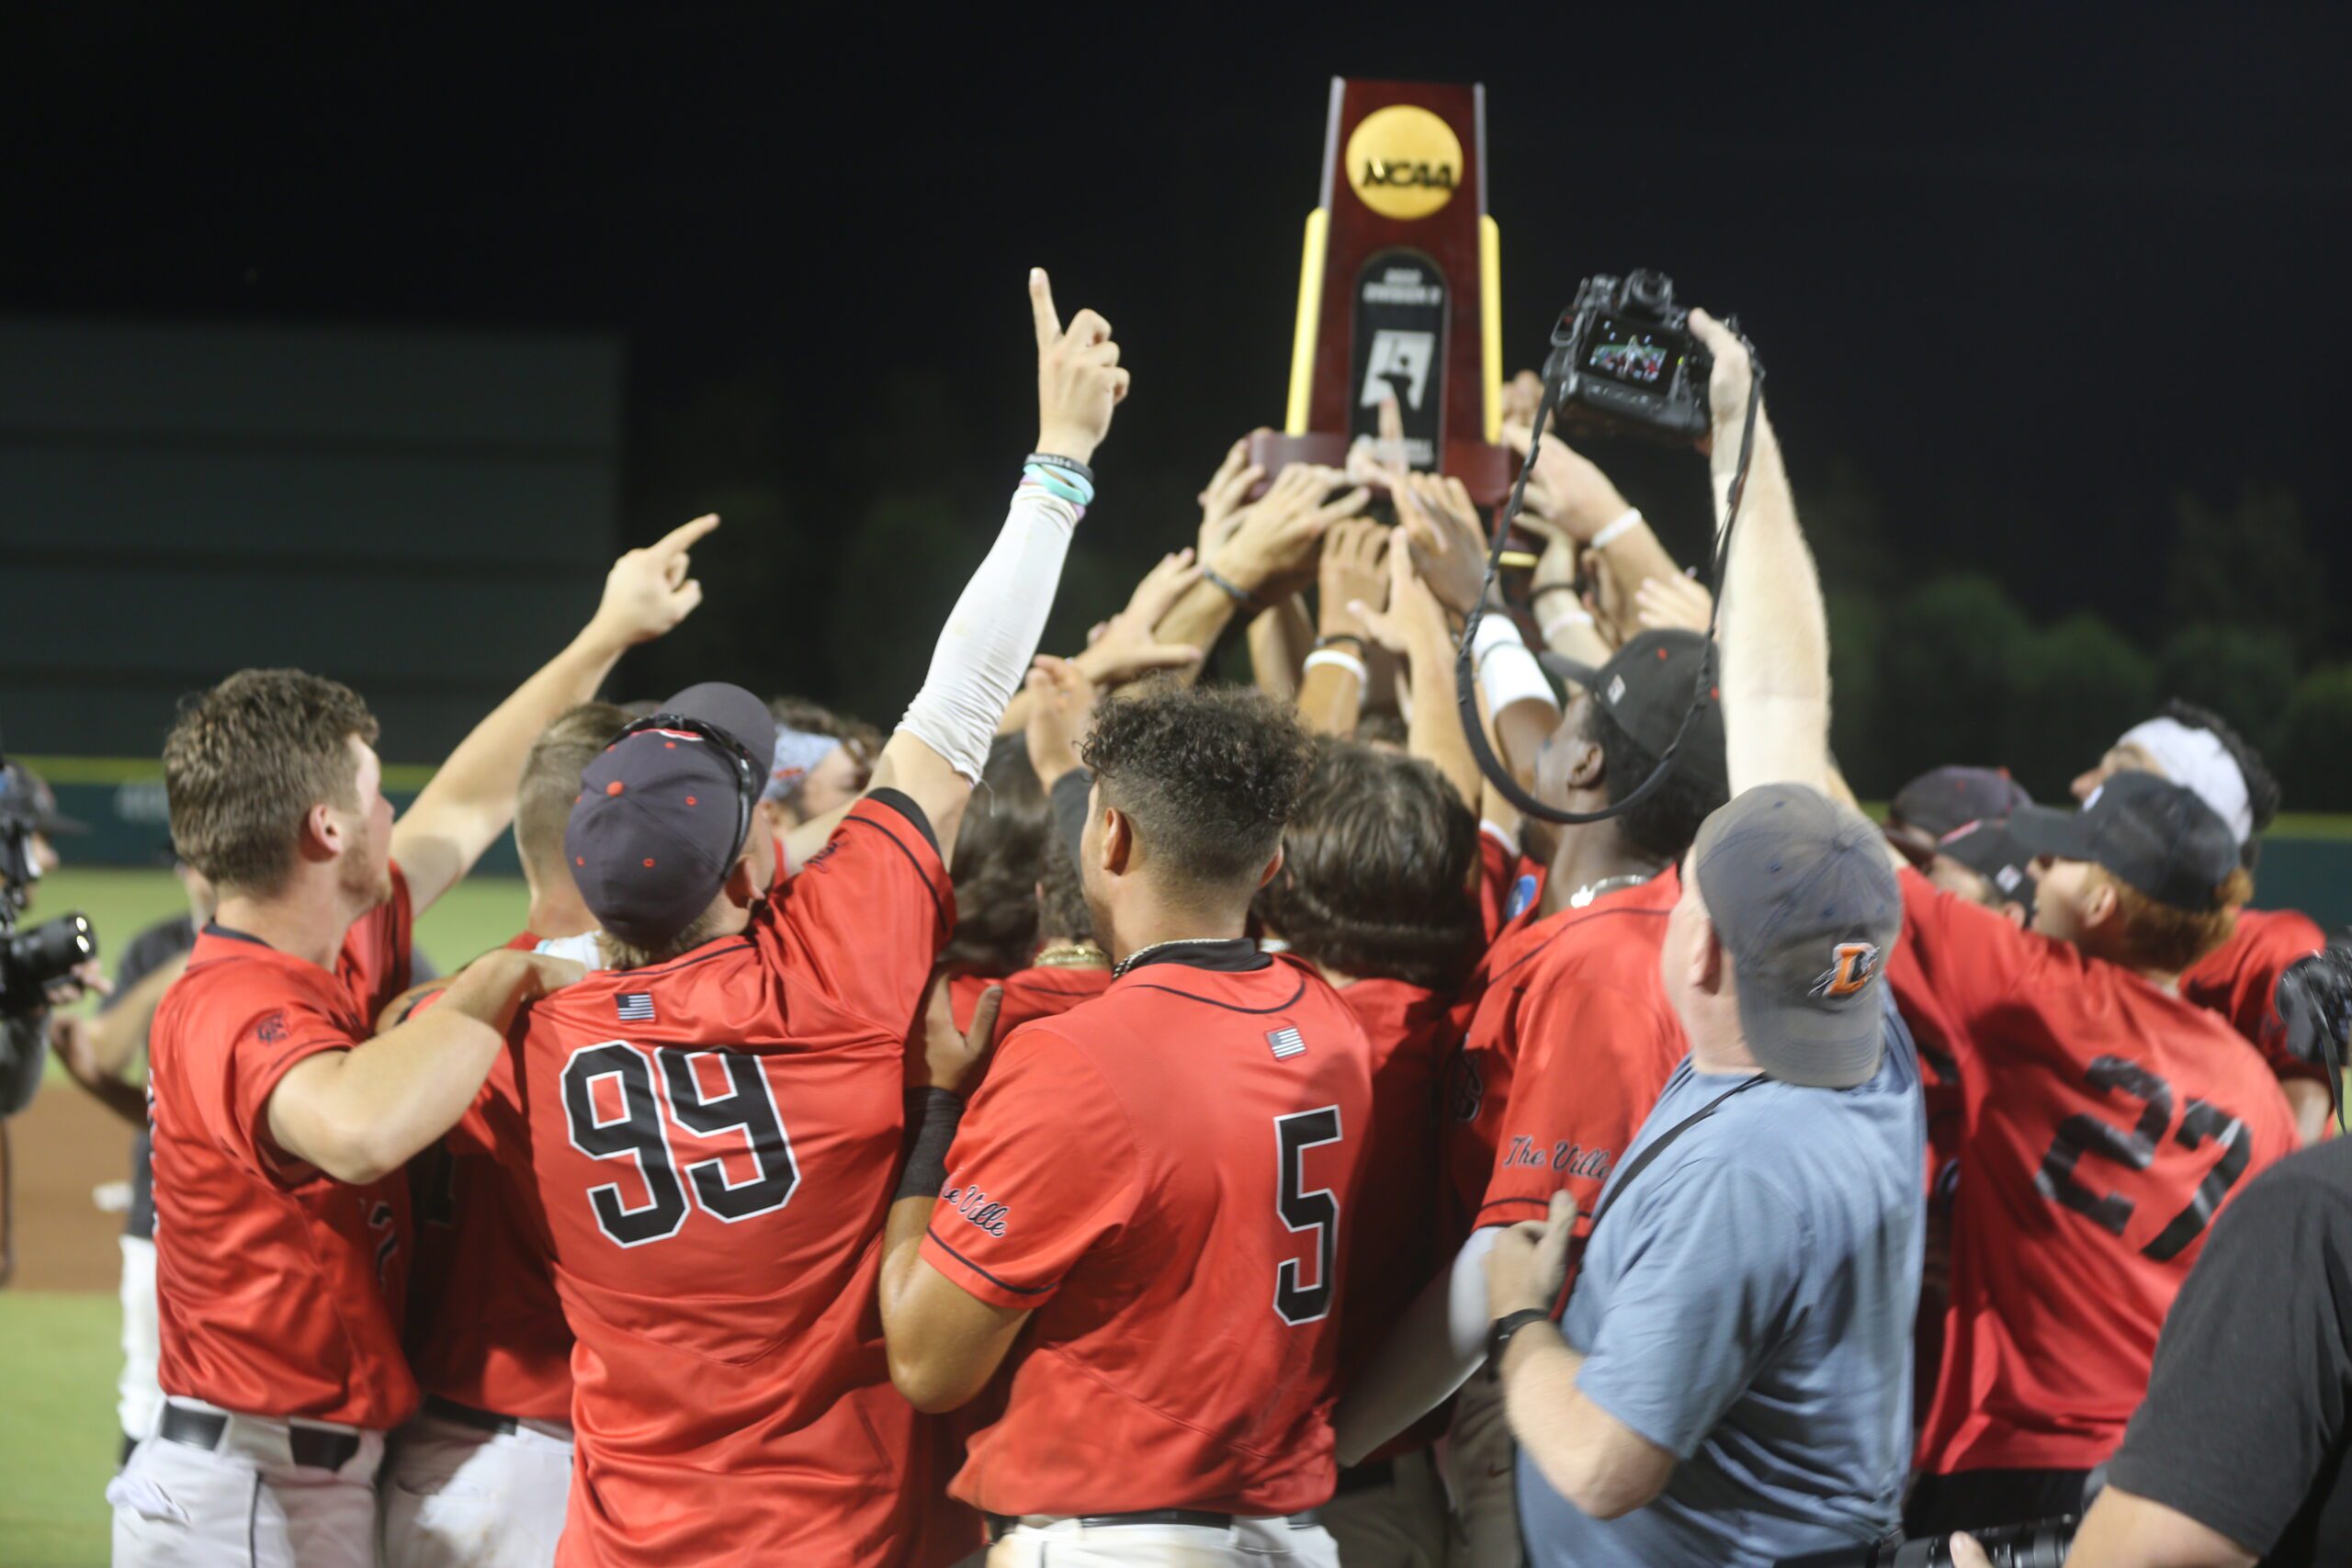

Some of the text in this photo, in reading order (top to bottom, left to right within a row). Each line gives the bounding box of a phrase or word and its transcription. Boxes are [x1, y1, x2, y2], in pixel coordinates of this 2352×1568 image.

[1363, 159, 1453, 189] NCAA
[560, 1040, 801, 1248] 99
[1503, 1134, 1612, 1180] The Ville
[2033, 1054, 2253, 1262] 27
[958, 1184, 1011, 1238] Ville
[1272, 1104, 1343, 1325] 5
